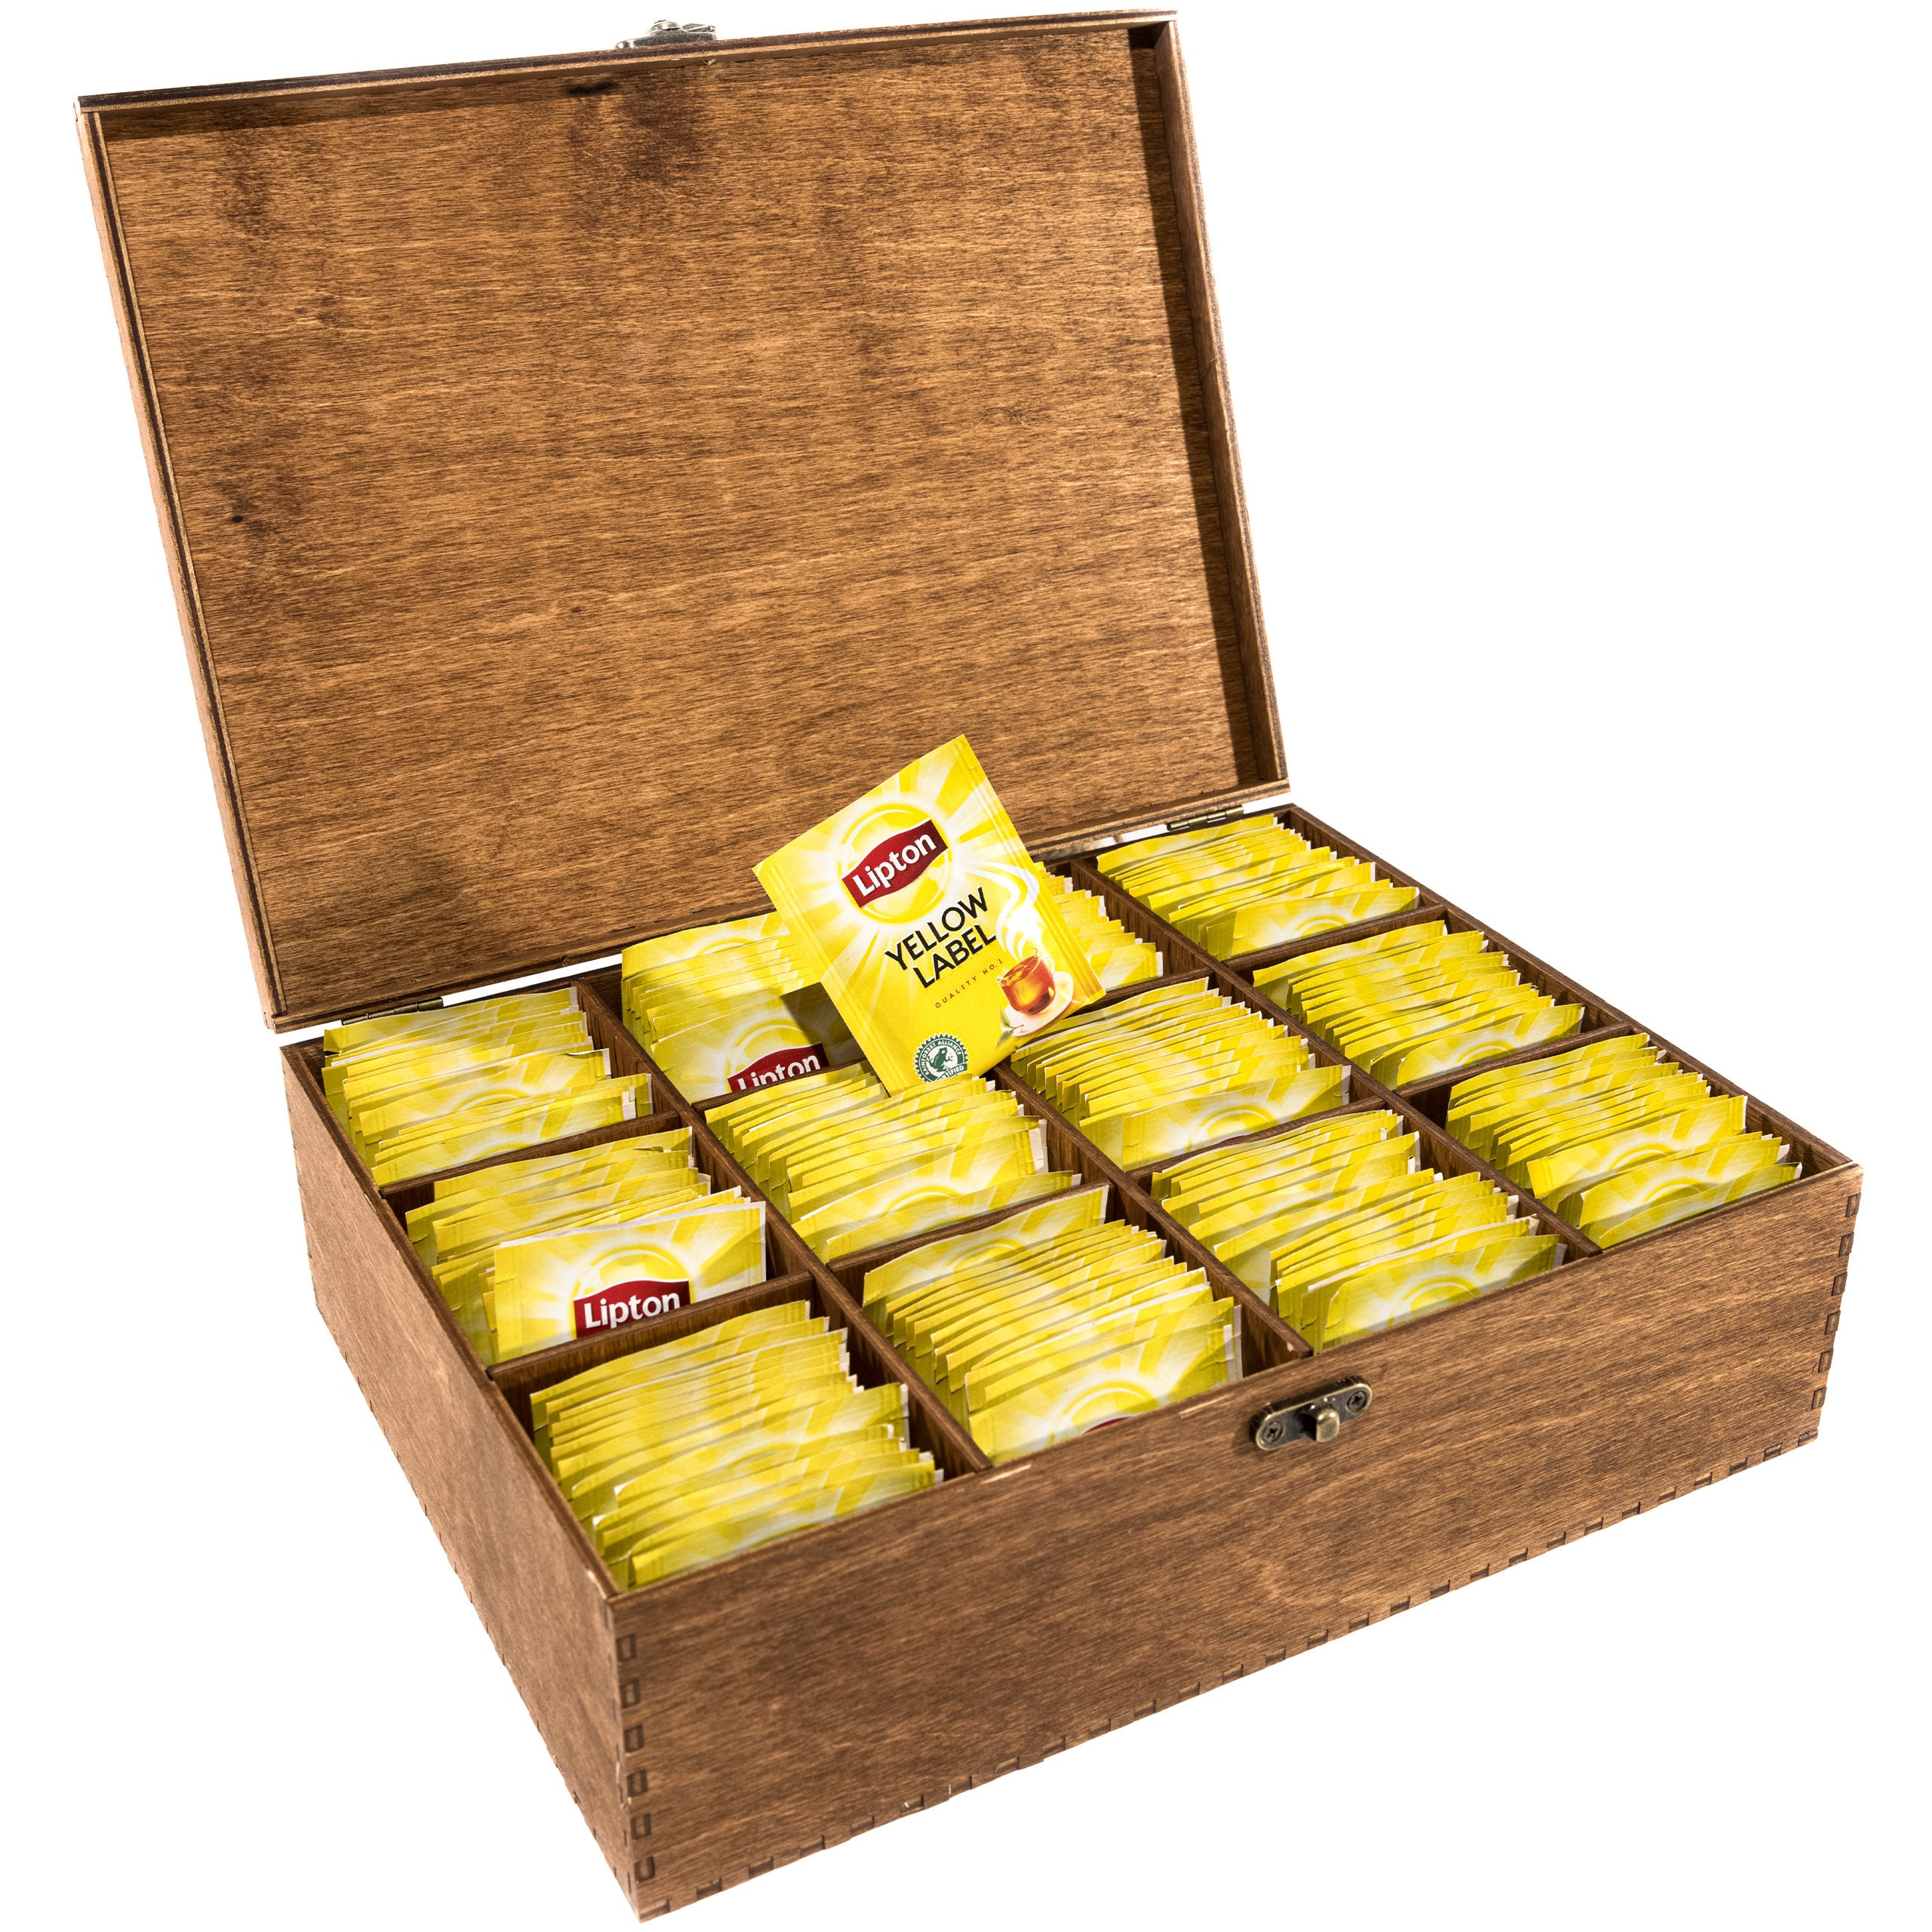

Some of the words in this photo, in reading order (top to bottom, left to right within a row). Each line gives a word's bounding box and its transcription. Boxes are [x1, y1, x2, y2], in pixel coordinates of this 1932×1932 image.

[852, 834, 937, 897] Lipton
[884, 887, 988, 971] YELLOW
[912, 924, 996, 989] LABEL
[935, 975, 977, 1008] QUALITY
[921, 1041, 937, 1075] RAINFOREST
[937, 1040, 962, 1055] ALLIANCE
[584, 1293, 681, 1329] Lipton
